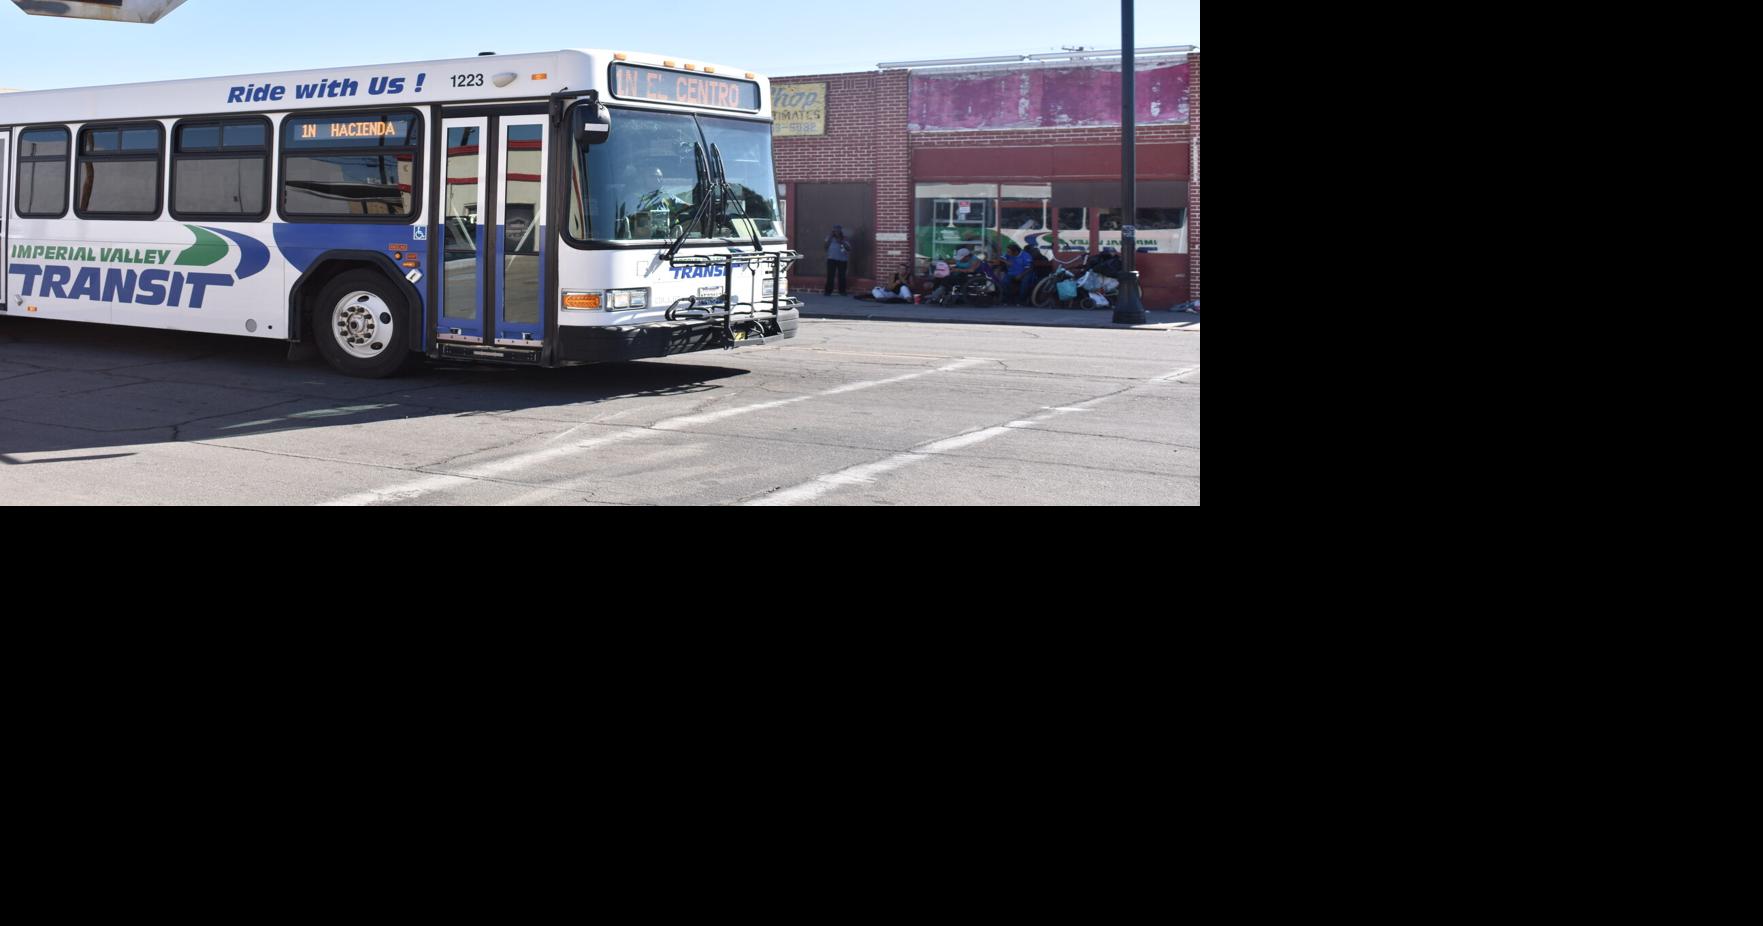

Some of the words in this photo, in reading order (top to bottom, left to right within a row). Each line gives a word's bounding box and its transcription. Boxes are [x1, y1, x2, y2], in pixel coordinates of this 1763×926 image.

[227, 83, 286, 103] Ride
[295, 77, 359, 100] with
[367, 75, 406, 96] Us
[414, 72, 426, 93] !
[450, 73, 484, 88] 1223
[676, 76, 740, 108] CENTRO
[770, 86, 818, 112] hop
[771, 110, 821, 121] TIMATES
[301, 123, 317, 138] 1N
[330, 121, 396, 138] HACIENDA
[10, 244, 96, 262] IMPERIAL
[100, 247, 171, 265] VALLEY
[8, 263, 235, 309] TRANSIT
